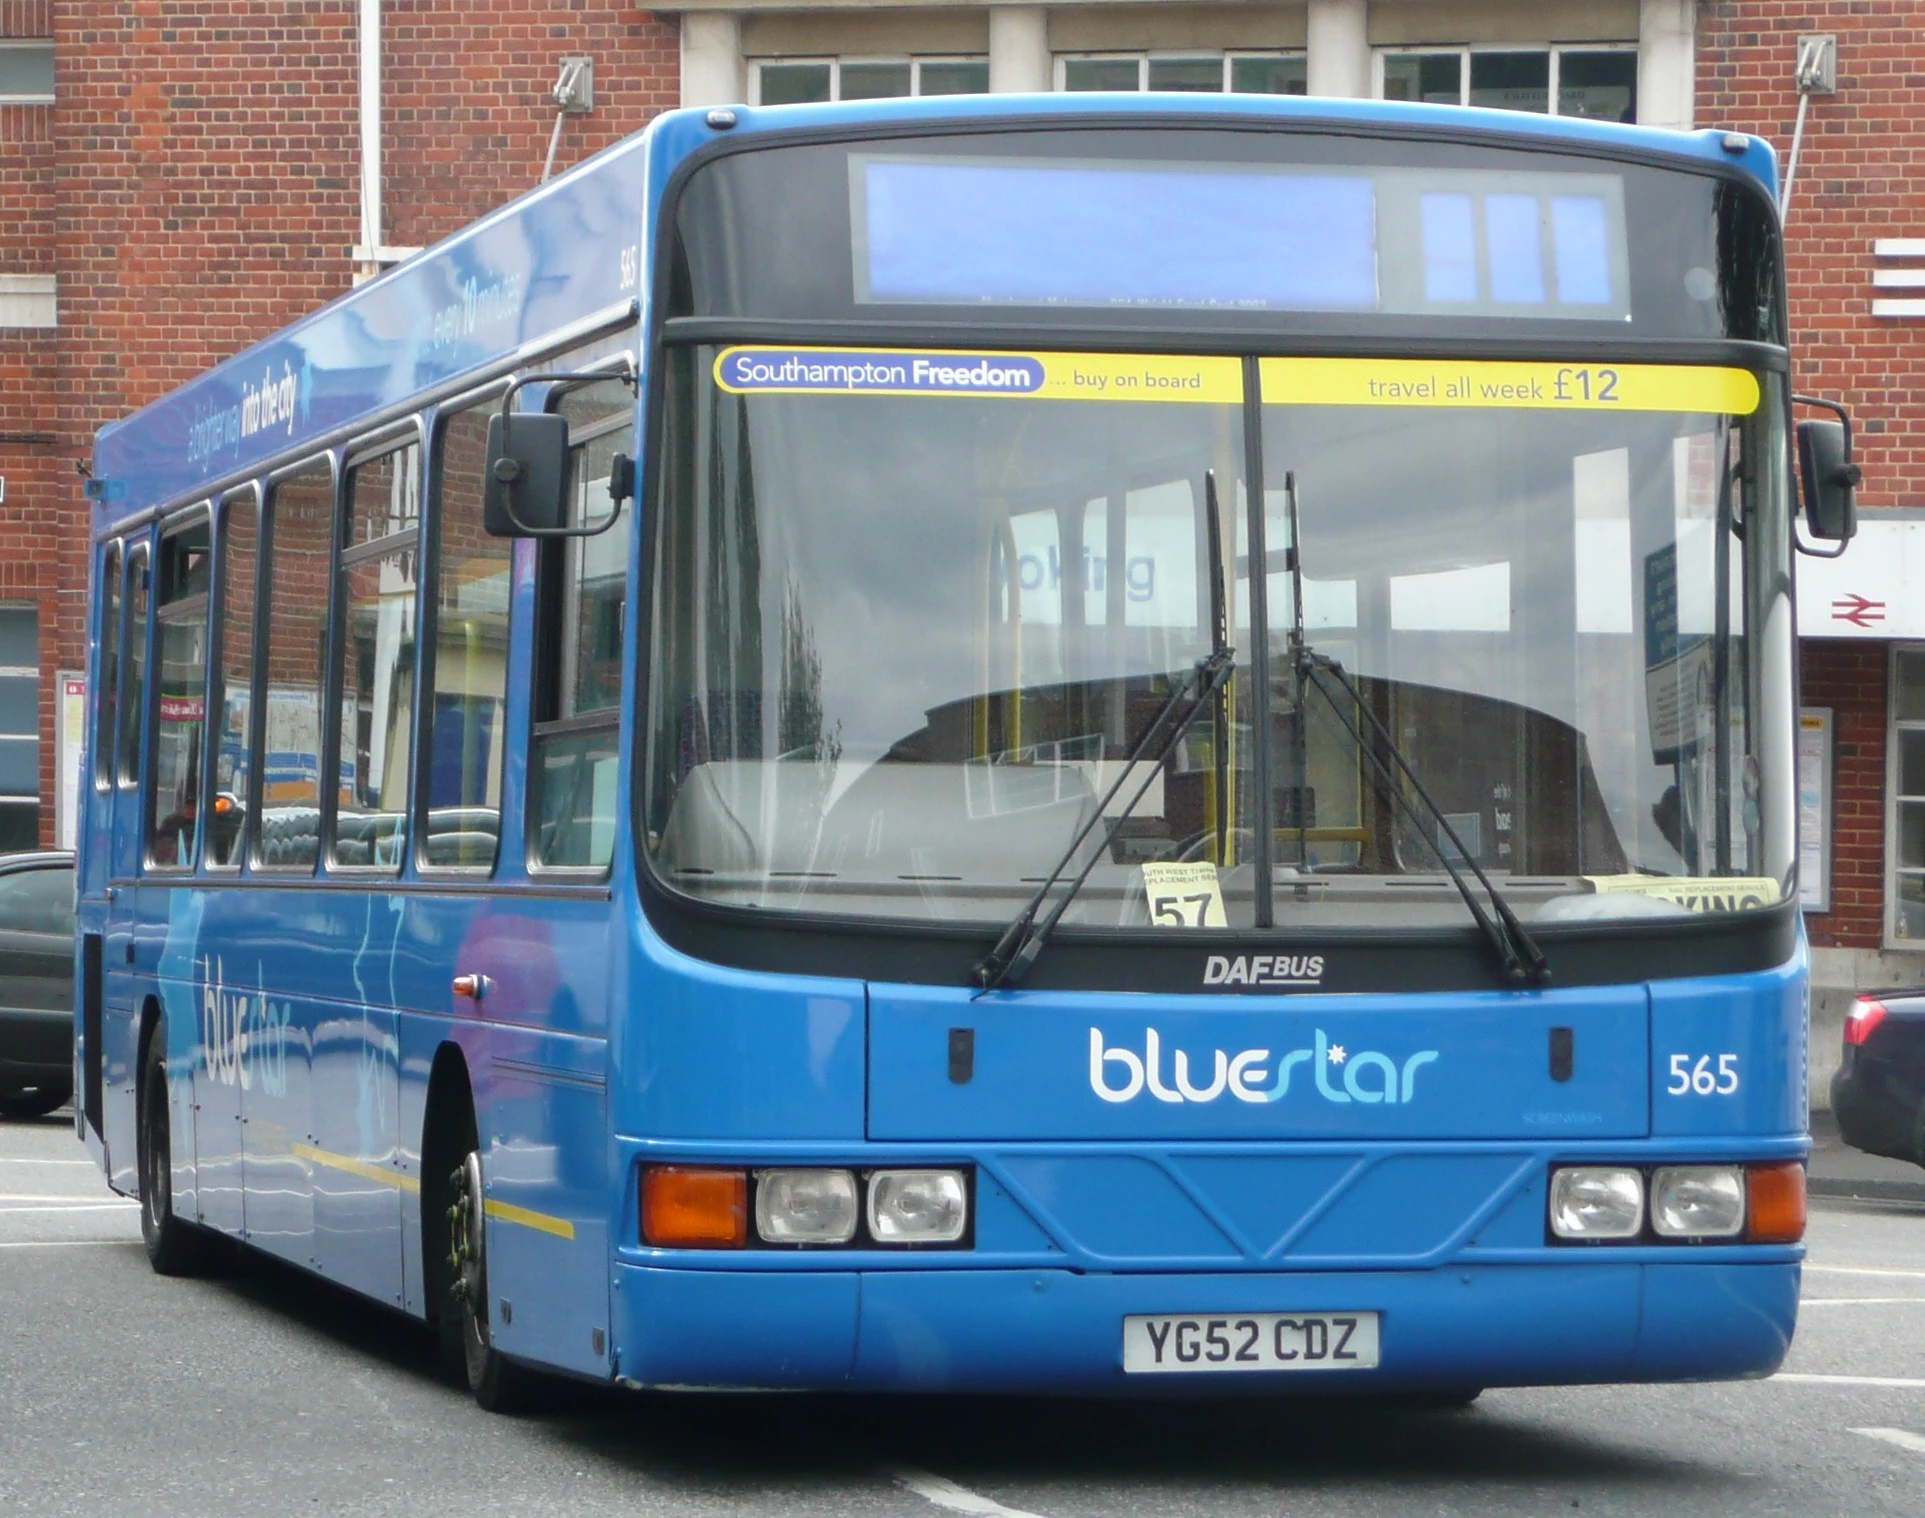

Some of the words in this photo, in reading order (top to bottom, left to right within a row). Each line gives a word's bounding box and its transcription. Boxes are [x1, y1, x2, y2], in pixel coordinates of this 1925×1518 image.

[619, 245, 636, 290] 565
[463, 275, 477, 335] 10
[736, 356, 905, 389] Southampton
[912, 360, 1030, 386] Freedom
[1073, 369, 1108, 391] buy
[1115, 375, 1138, 387] on
[1145, 371, 1201, 389] board
[1368, 376, 1436, 398] travel
[1446, 376, 1471, 398] all
[1480, 378, 1543, 400] week
[1553, 368, 1619, 401] £12
[241, 380, 260, 438] into
[261, 365, 278, 429] the
[278, 359, 297, 436] city
[1145, 867, 1164, 877] UTH
[1146, 875, 1199, 885] PLACEMENT
[1155, 893, 1213, 927] 57
[1090, 1027, 1439, 1103] bluestar
[1667, 1054, 1738, 1095] 565
[1146, 1319, 1259, 1363] YG52
[1274, 1318, 1357, 1361] CDZ
